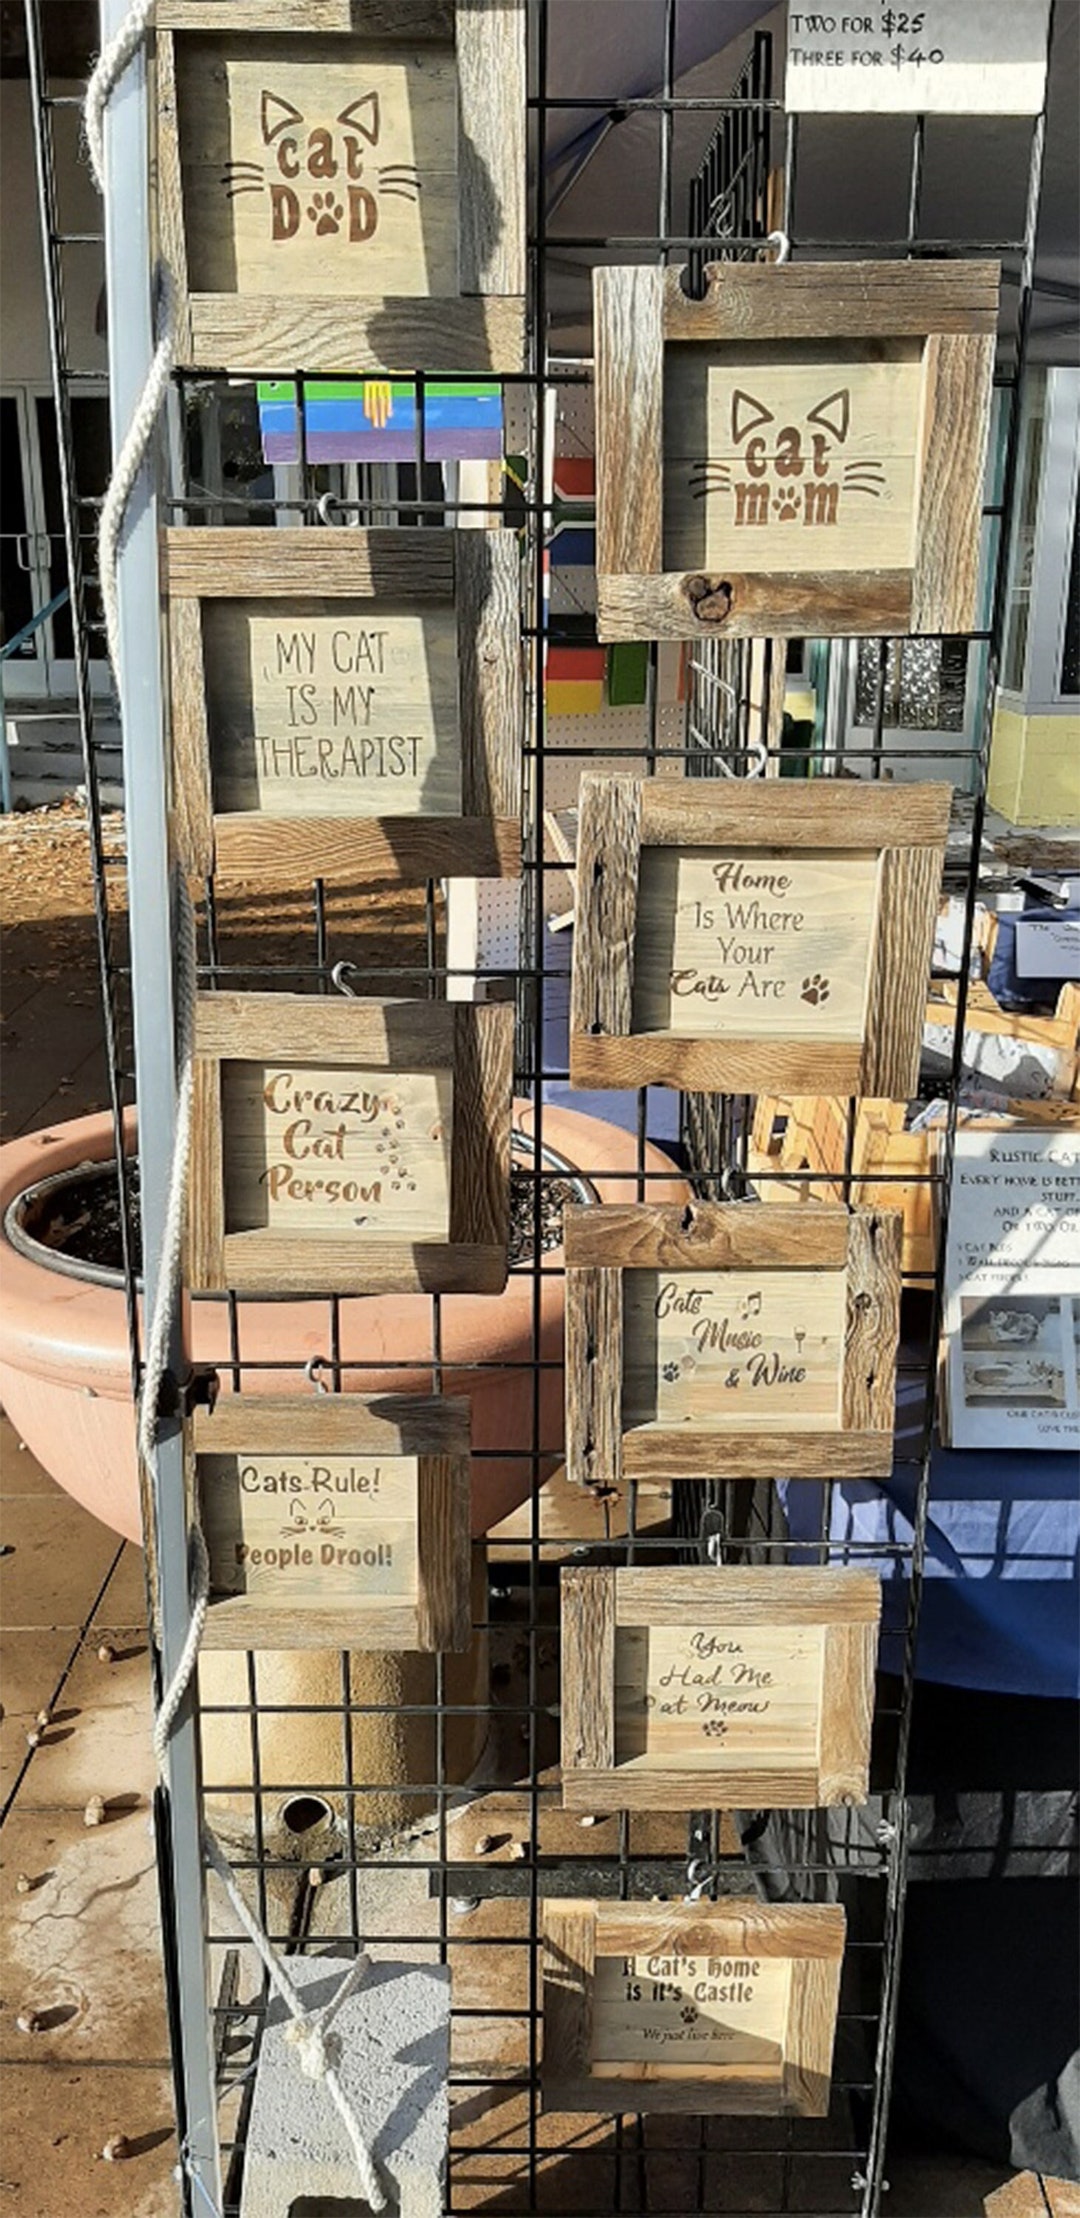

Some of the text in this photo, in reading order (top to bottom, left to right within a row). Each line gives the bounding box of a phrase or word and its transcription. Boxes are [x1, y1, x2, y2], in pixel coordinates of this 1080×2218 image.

[881, 9, 925, 38] $25
[891, 44, 944, 71] $40
[277, 127, 364, 179] cat
[745, 426, 832, 478] cat
[276, 630, 389, 674] MY CAT
[286, 684, 373, 727] IS MY
[255, 735, 423, 779] THERAPIST
[712, 862, 792, 898] Home
[694, 901, 804, 931] Is Where
[716, 937, 775, 965] Your
[669, 969, 786, 1002] Cats Are
[263, 1073, 380, 1123] Crazy
[283, 1119, 365, 1161] Cat
[259, 1163, 382, 1203] Person
[655, 1282, 713, 1319] Cats
[692, 1318, 763, 1353] Music
[725, 1352, 806, 1389] & Wine
[241, 1466, 381, 1494] Cats Rule!
[235, 1543, 393, 1569] People Drool!
[690, 1632, 743, 1659] You
[659, 1663, 774, 1688] Had Me
[660, 1692, 770, 1715] at Meow
[647, 1956, 697, 1976] Cat's
[694, 1982, 753, 2002] Castle
